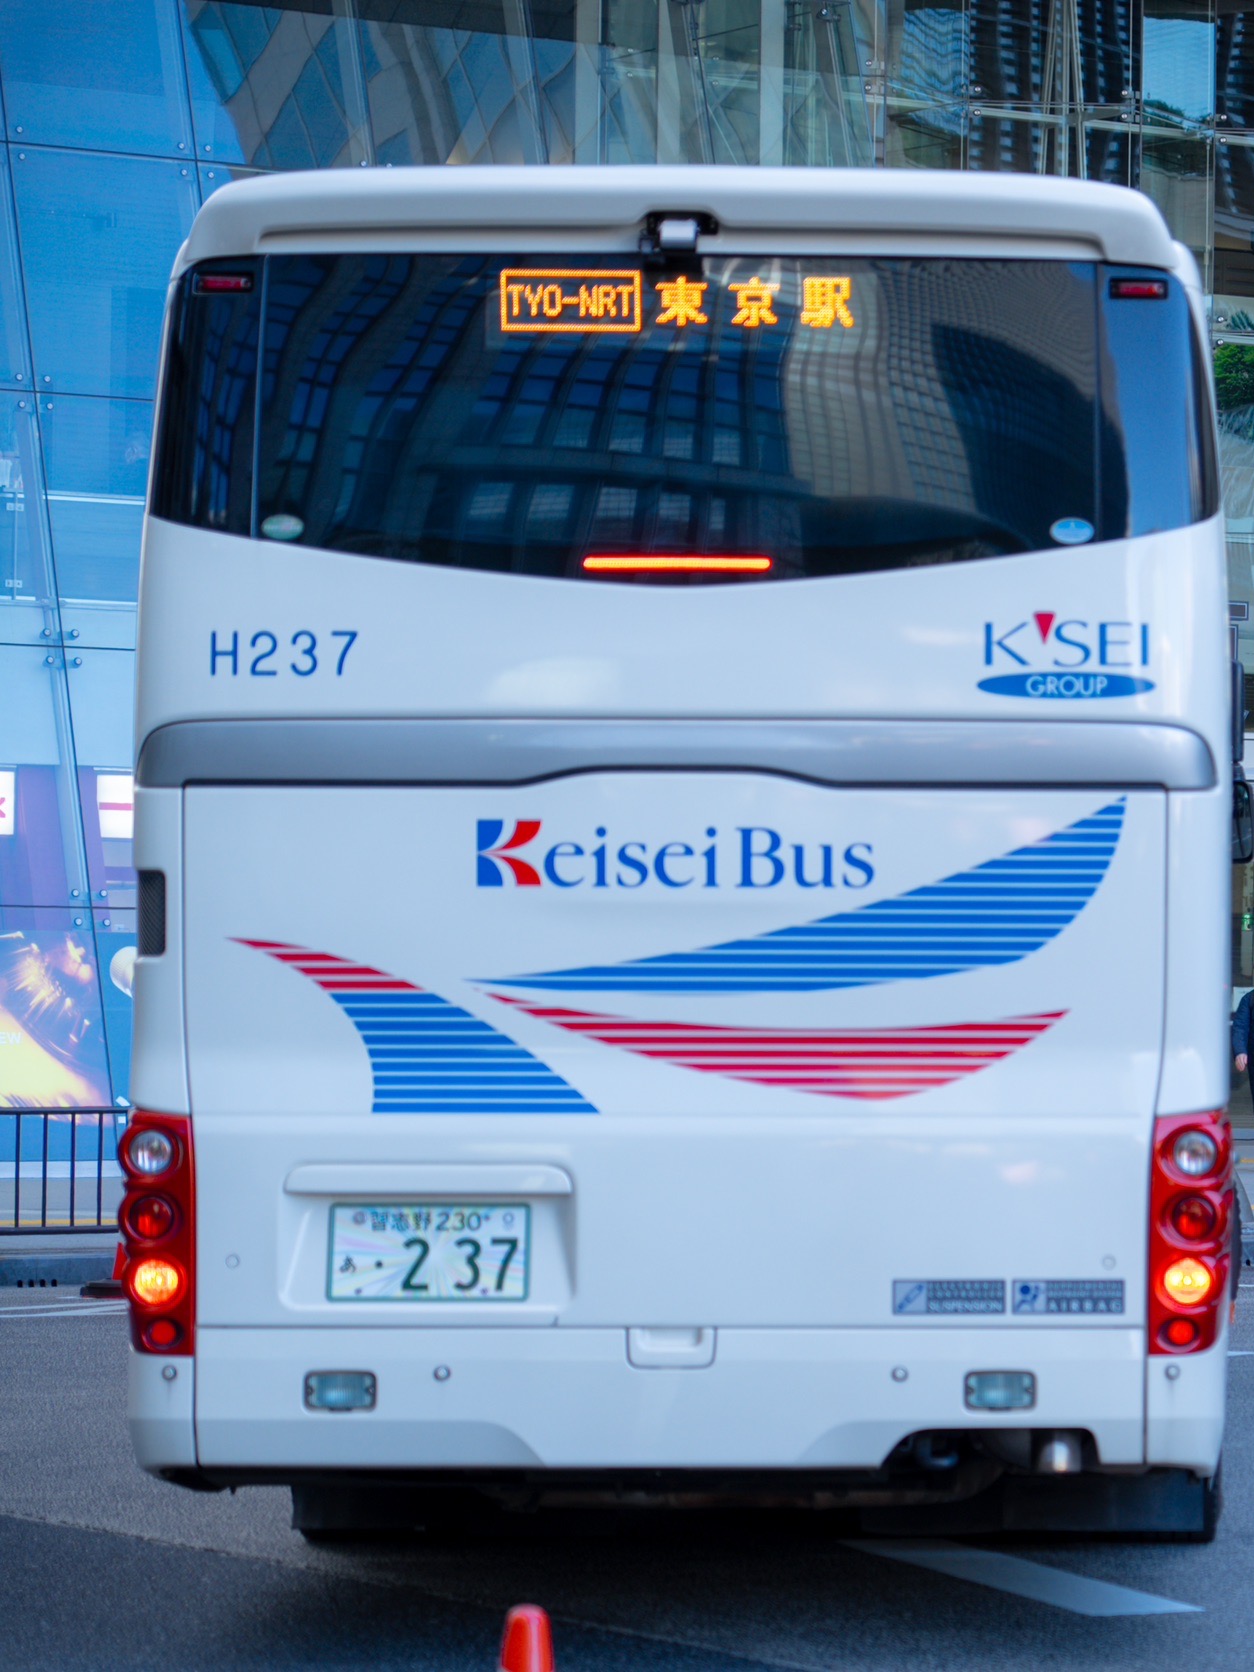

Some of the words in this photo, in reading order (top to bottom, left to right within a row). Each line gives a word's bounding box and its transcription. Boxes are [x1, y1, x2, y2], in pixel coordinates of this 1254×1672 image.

[506, 283, 635, 318] TYO-NRT
[655, 275, 854, 327] 東京駅
[210, 629, 358, 677] H237
[1026, 675, 1107, 696] GROUP
[476, 819, 720, 888] Keisei
[734, 826, 875, 889] Bus
